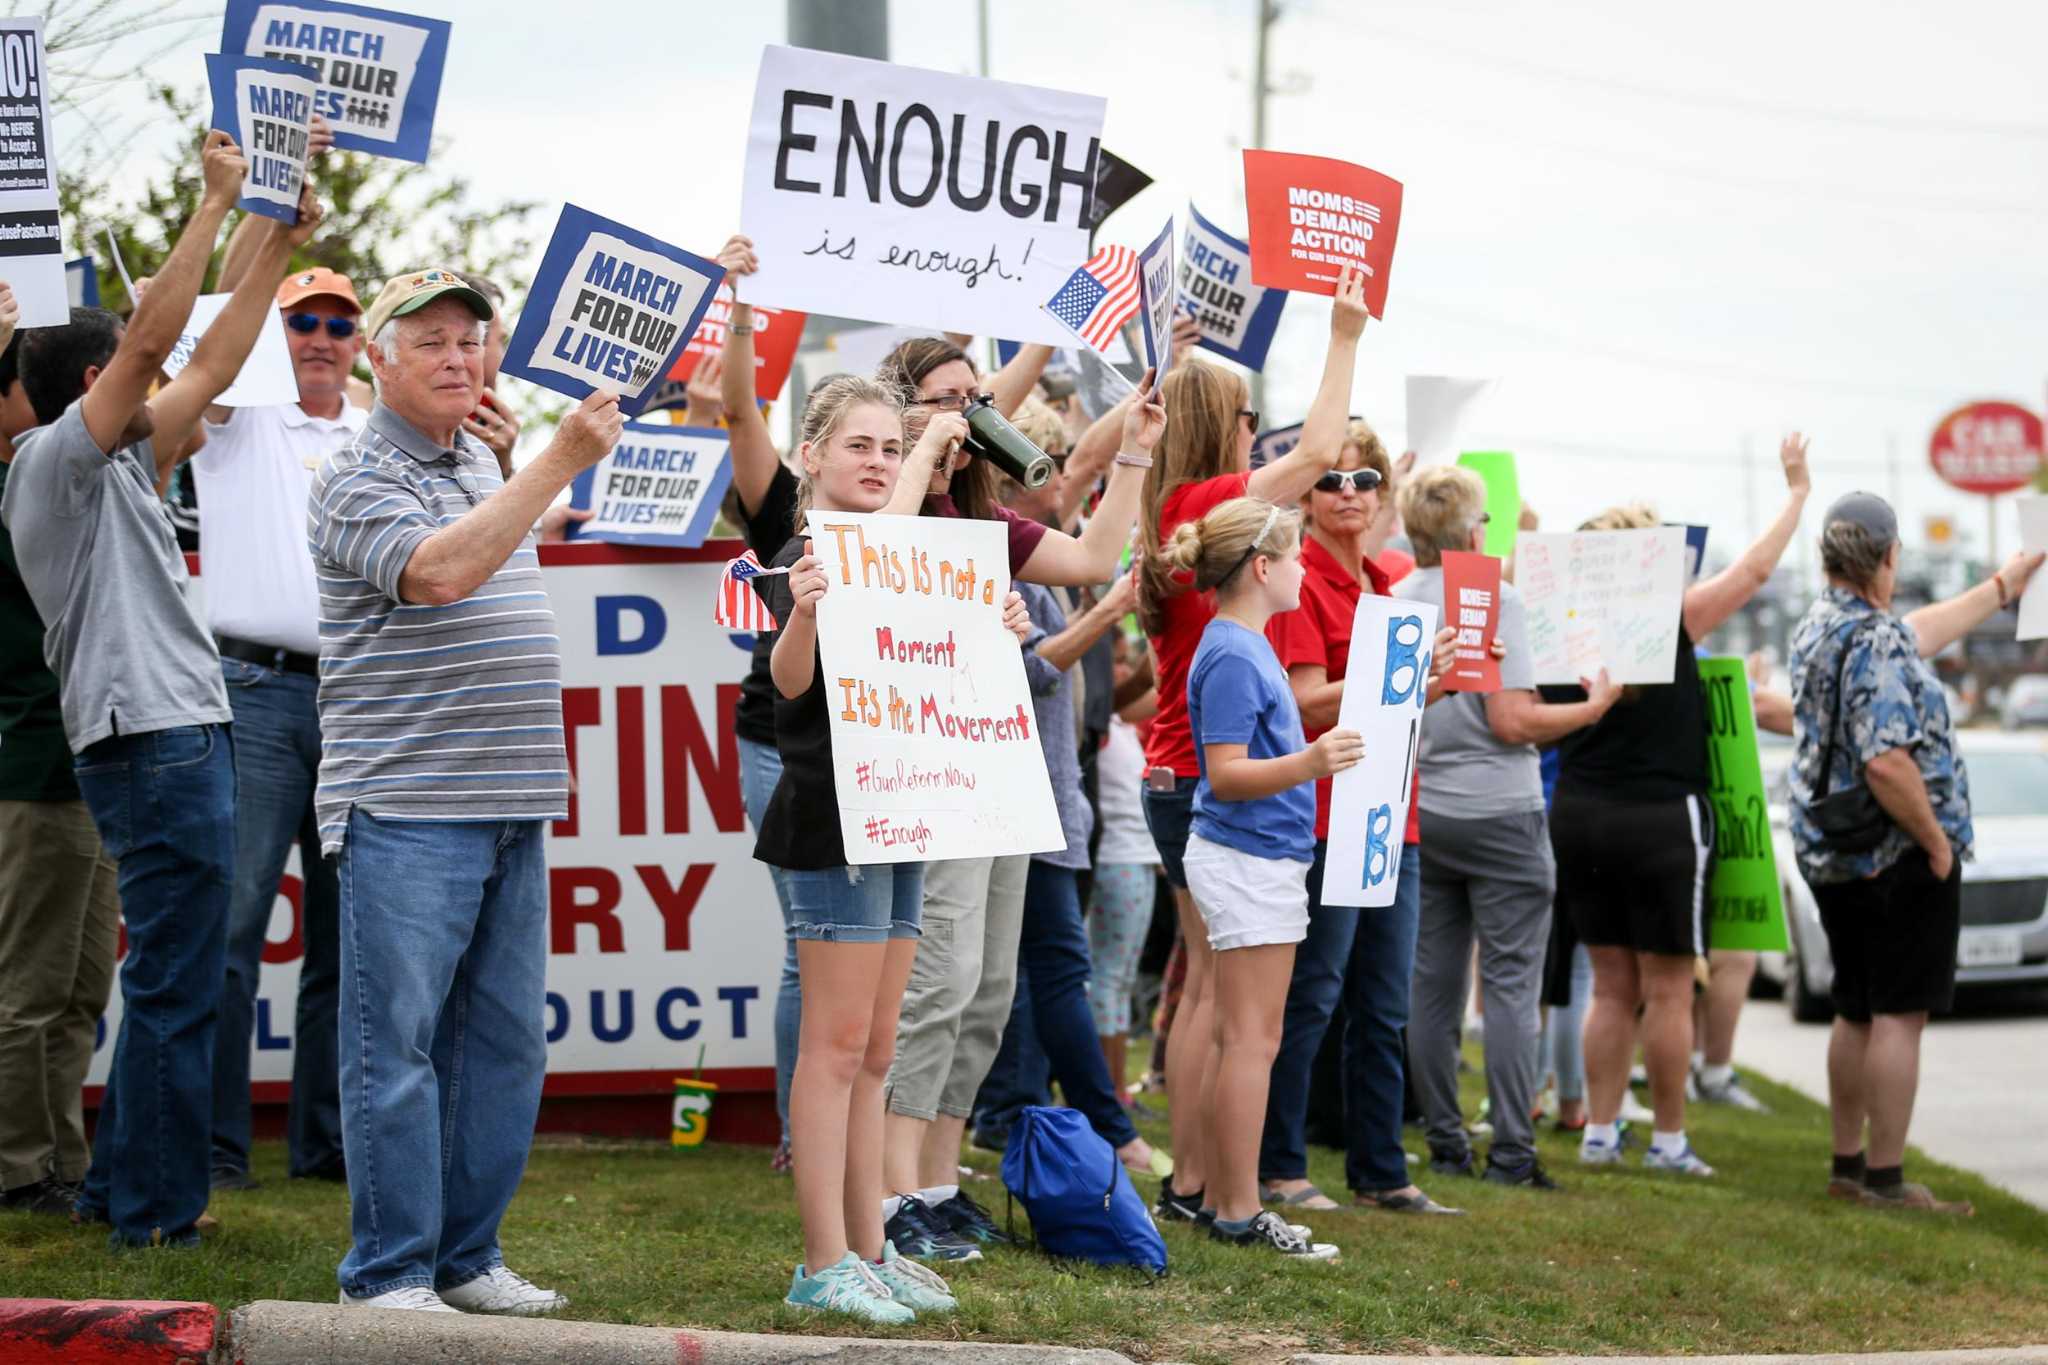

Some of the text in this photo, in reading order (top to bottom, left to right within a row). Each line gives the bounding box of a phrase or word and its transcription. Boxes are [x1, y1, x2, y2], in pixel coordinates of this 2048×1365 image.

[264, 19, 384, 62] MARCH
[329, 59, 398, 98] OUR
[249, 84, 311, 126] MARCH
[253, 119, 287, 155] FOR
[252, 155, 291, 192] LIVES
[774, 89, 1101, 230] ENOUGH
[1289, 187, 1354, 215] MOMS
[1290, 207, 1373, 241] DEMAND
[1291, 228, 1366, 259] ACTION
[804, 229, 1035, 289] is enough!
[1291, 248, 1308, 260] FOR
[584, 251, 683, 316] MARCH
[1191, 274, 1246, 316] OUR
[570, 288, 634, 340] FOR
[629, 311, 678, 356] OUR
[552, 325, 640, 384] LIVES
[612, 444, 697, 474] MARCH
[606, 473, 700, 501] FOR OUR
[598, 501, 660, 525] LIVES
[824, 523, 995, 605] This is not a
[876, 626, 957, 667] Moment
[838, 677, 1030, 743] It's the Movement
[864, 815, 933, 855] #Enough
